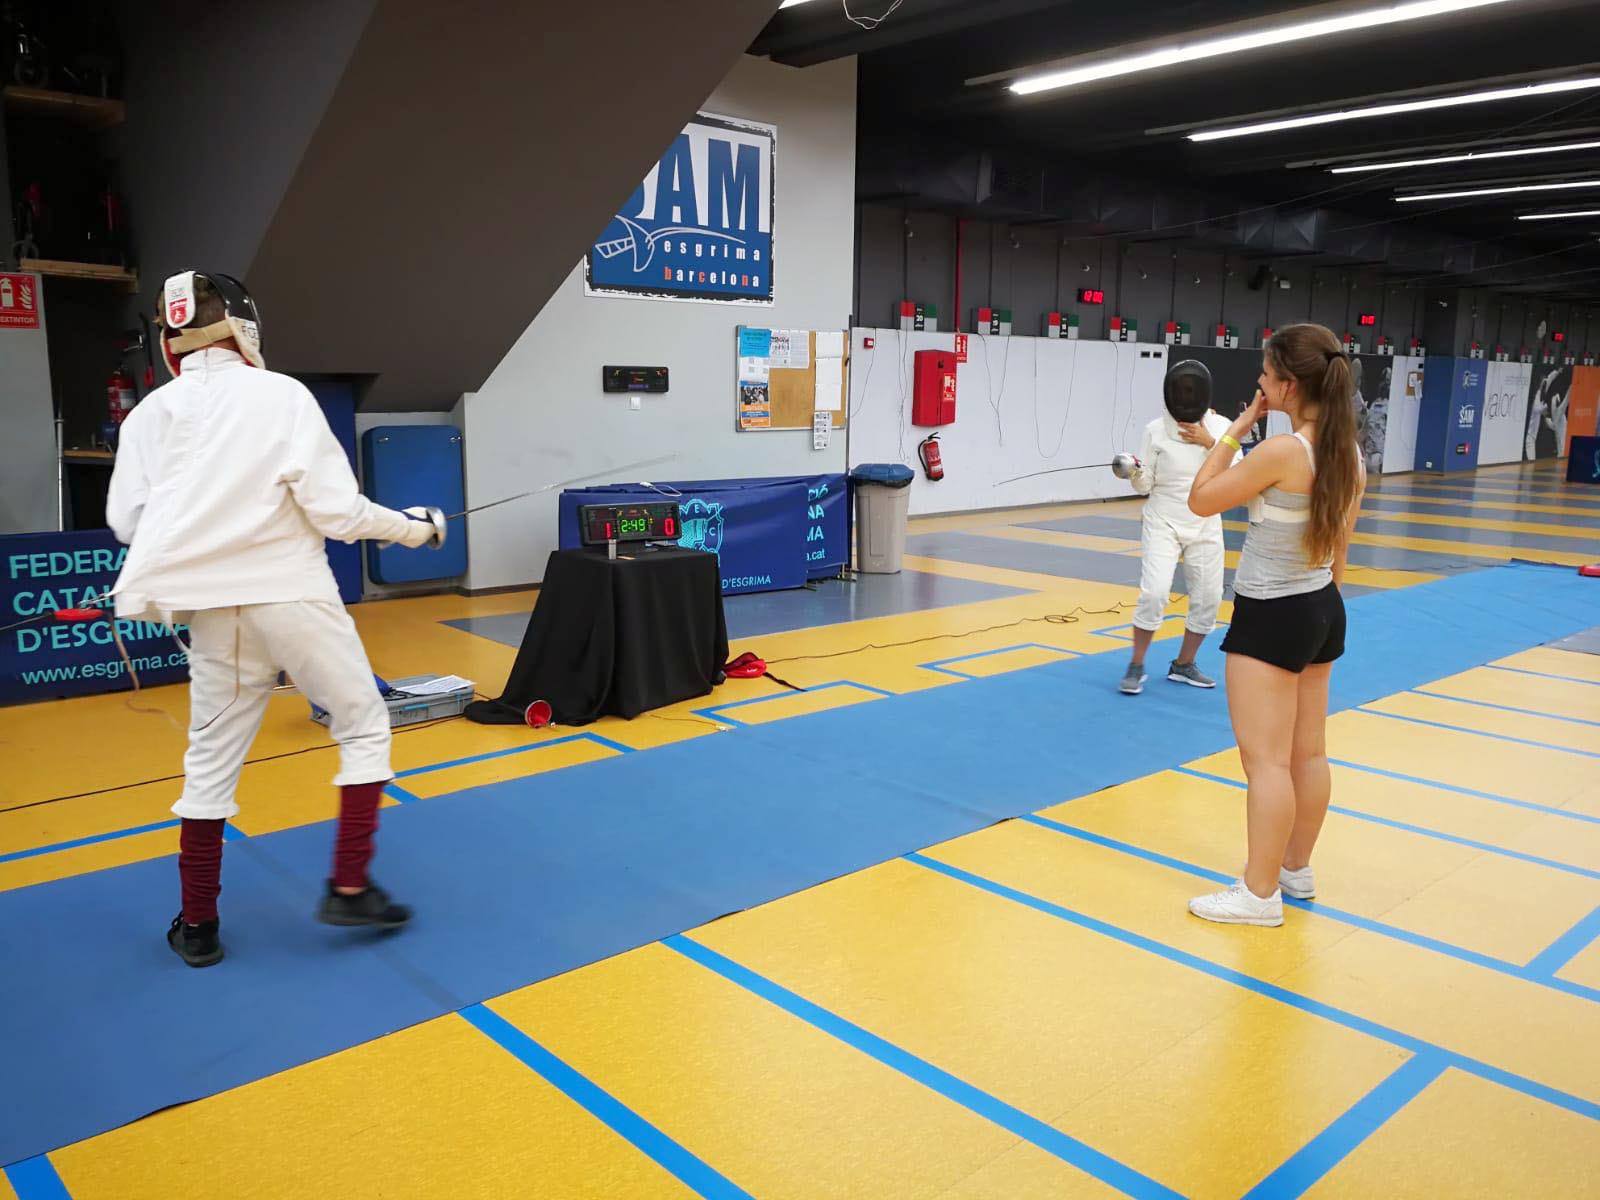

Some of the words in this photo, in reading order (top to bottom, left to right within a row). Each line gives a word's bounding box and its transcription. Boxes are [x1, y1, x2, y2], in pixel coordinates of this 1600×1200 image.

[664, 240, 760, 262] esgrima
[664, 266, 760, 288] barcelona
[722, 575, 771, 589] D'ESGRIMA
